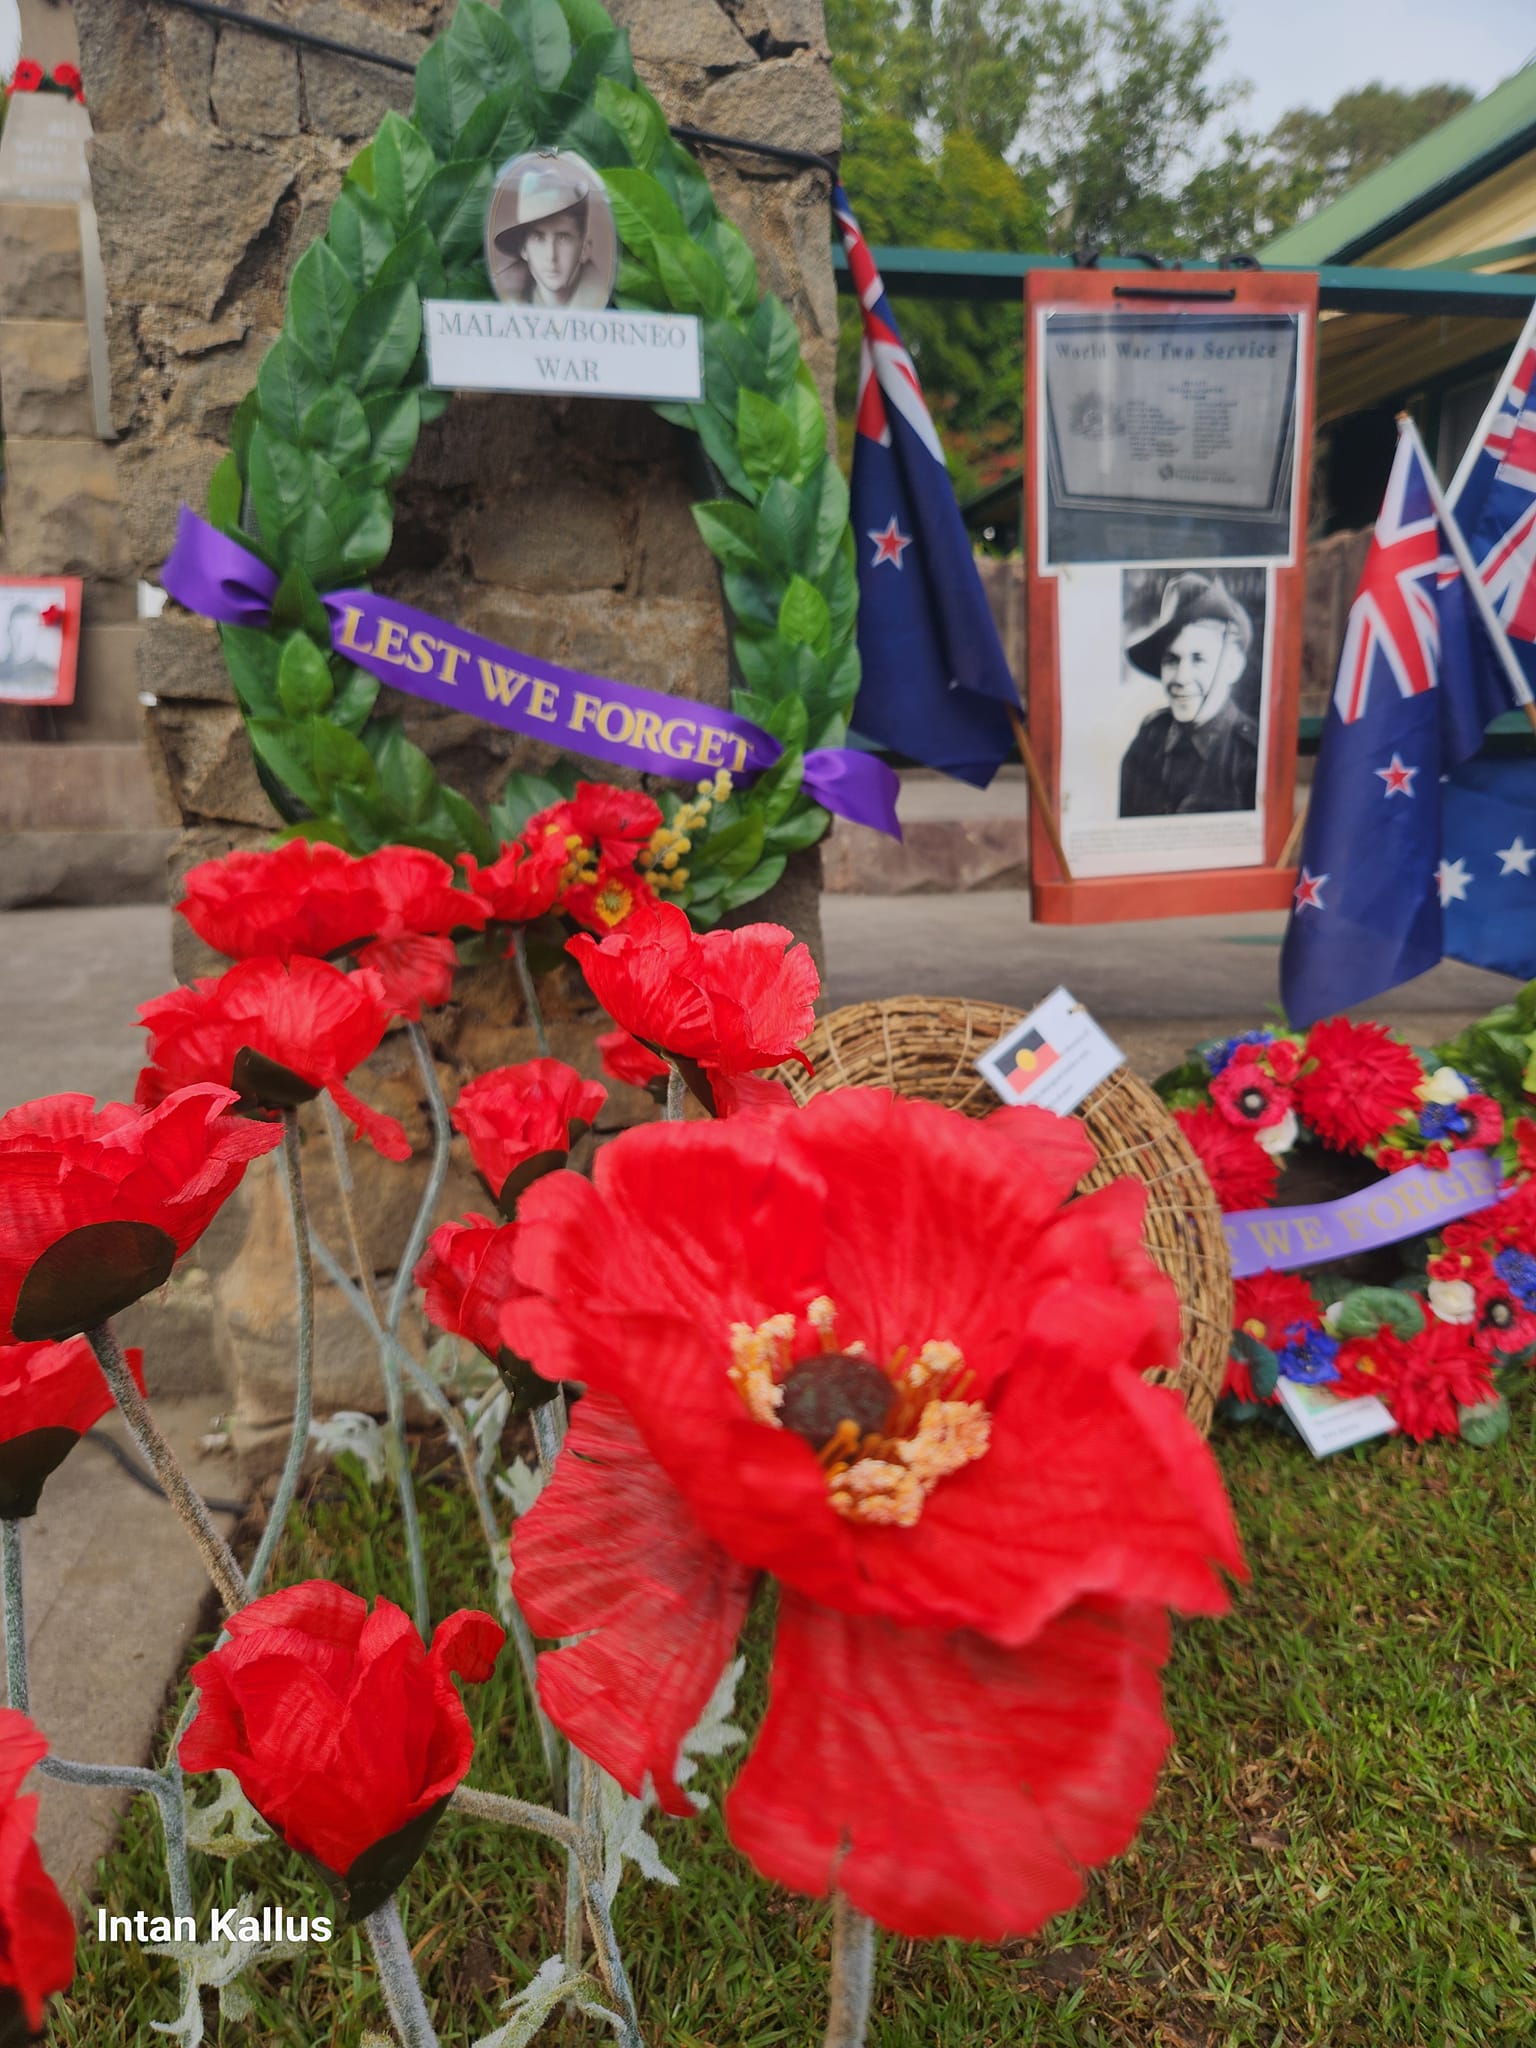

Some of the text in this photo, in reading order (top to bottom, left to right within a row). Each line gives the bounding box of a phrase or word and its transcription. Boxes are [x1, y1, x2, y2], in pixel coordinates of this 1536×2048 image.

[439, 313, 686, 348] MALAYA/BORNEO
[1116, 341, 1150, 361] War
[1159, 341, 1195, 361] Two
[1202, 338, 1279, 360] Service
[536, 357, 599, 383] WAR
[339, 606, 755, 773] LEST WE FORGET
[1246, 1215, 1332, 1258] WE
[1336, 1160, 1497, 1240] FORGE
